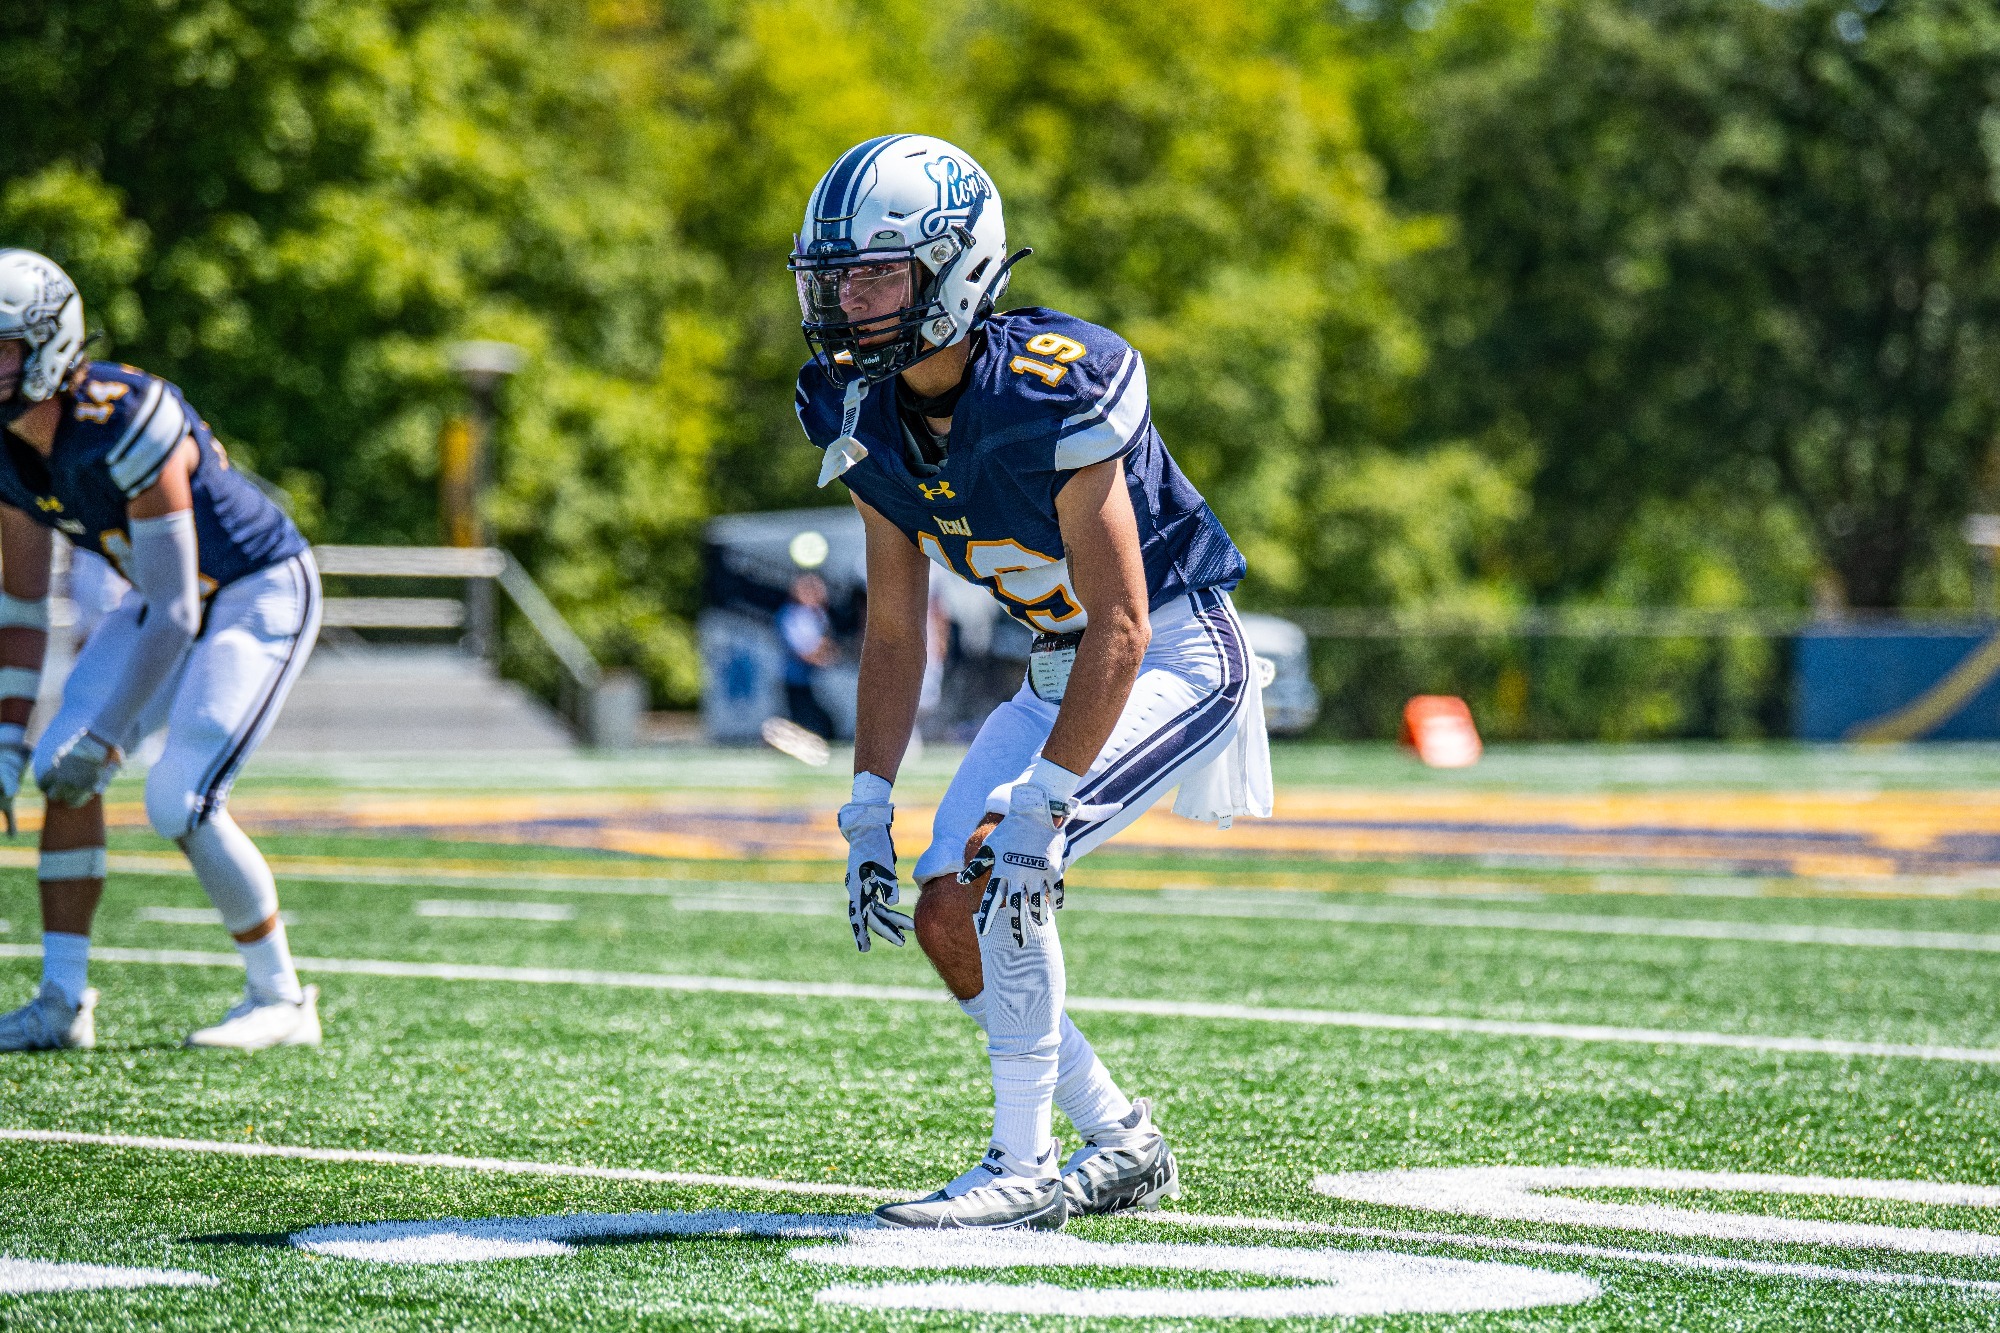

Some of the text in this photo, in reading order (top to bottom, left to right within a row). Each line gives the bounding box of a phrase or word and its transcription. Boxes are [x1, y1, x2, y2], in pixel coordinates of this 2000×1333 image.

[1009, 332, 1087, 388] 19
[933, 515, 972, 537] TCNJ
[1007, 854, 1045, 867] BATTLE
